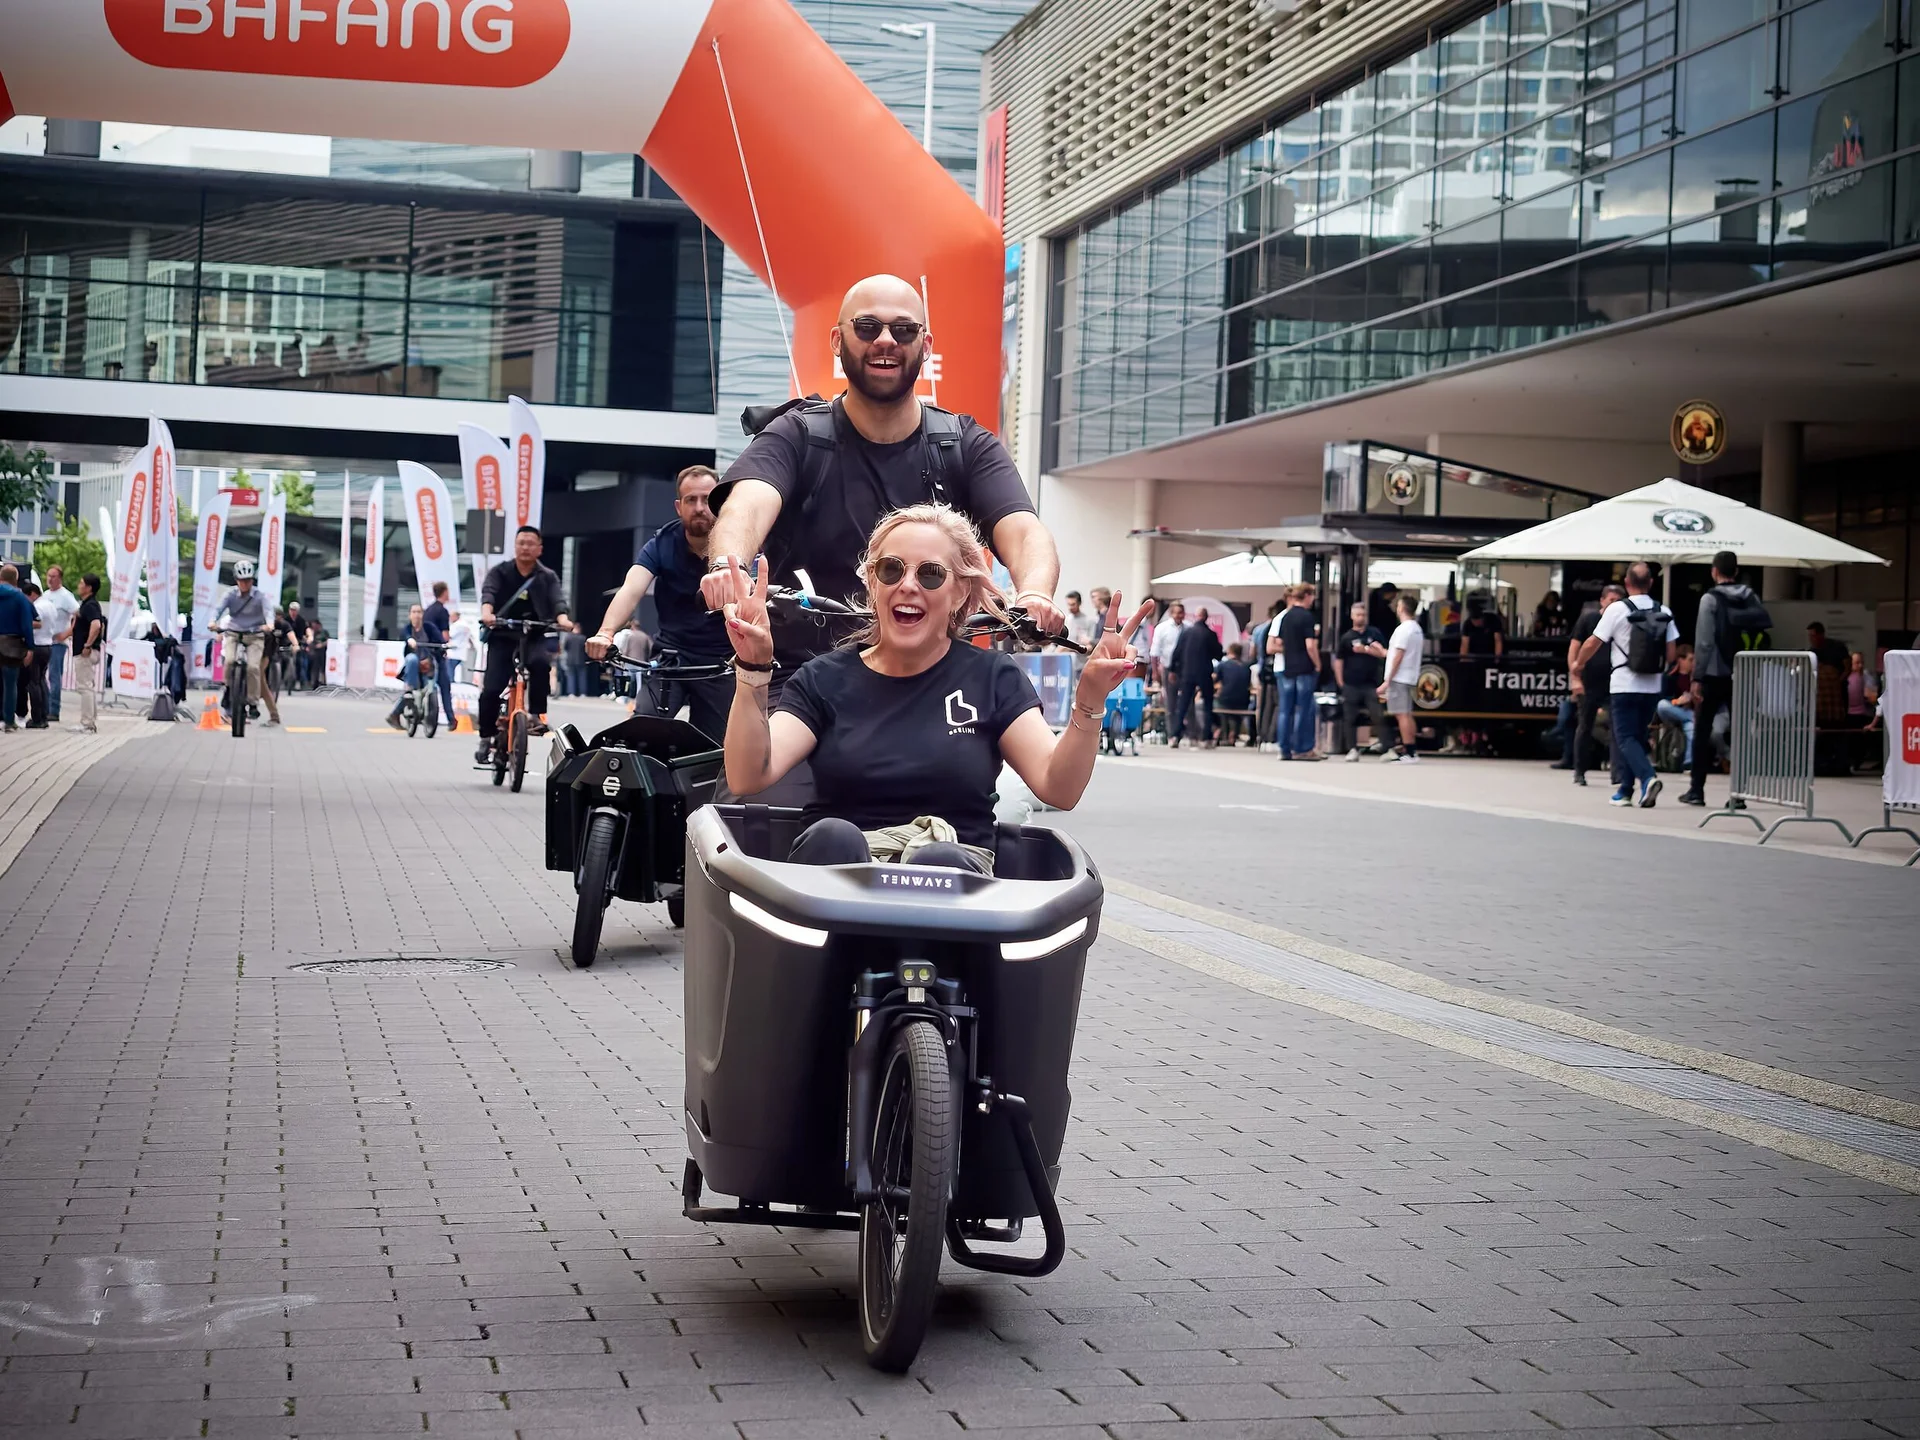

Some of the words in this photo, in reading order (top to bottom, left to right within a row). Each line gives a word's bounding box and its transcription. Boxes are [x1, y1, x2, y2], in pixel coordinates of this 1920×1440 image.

[163, 0, 514, 54] BAFANG
[480, 465, 498, 509] BAFA
[1485, 668, 1573, 690] Franzis
[1520, 694, 1570, 708] WEISS
[880, 874, 953, 889] TENWAYS
